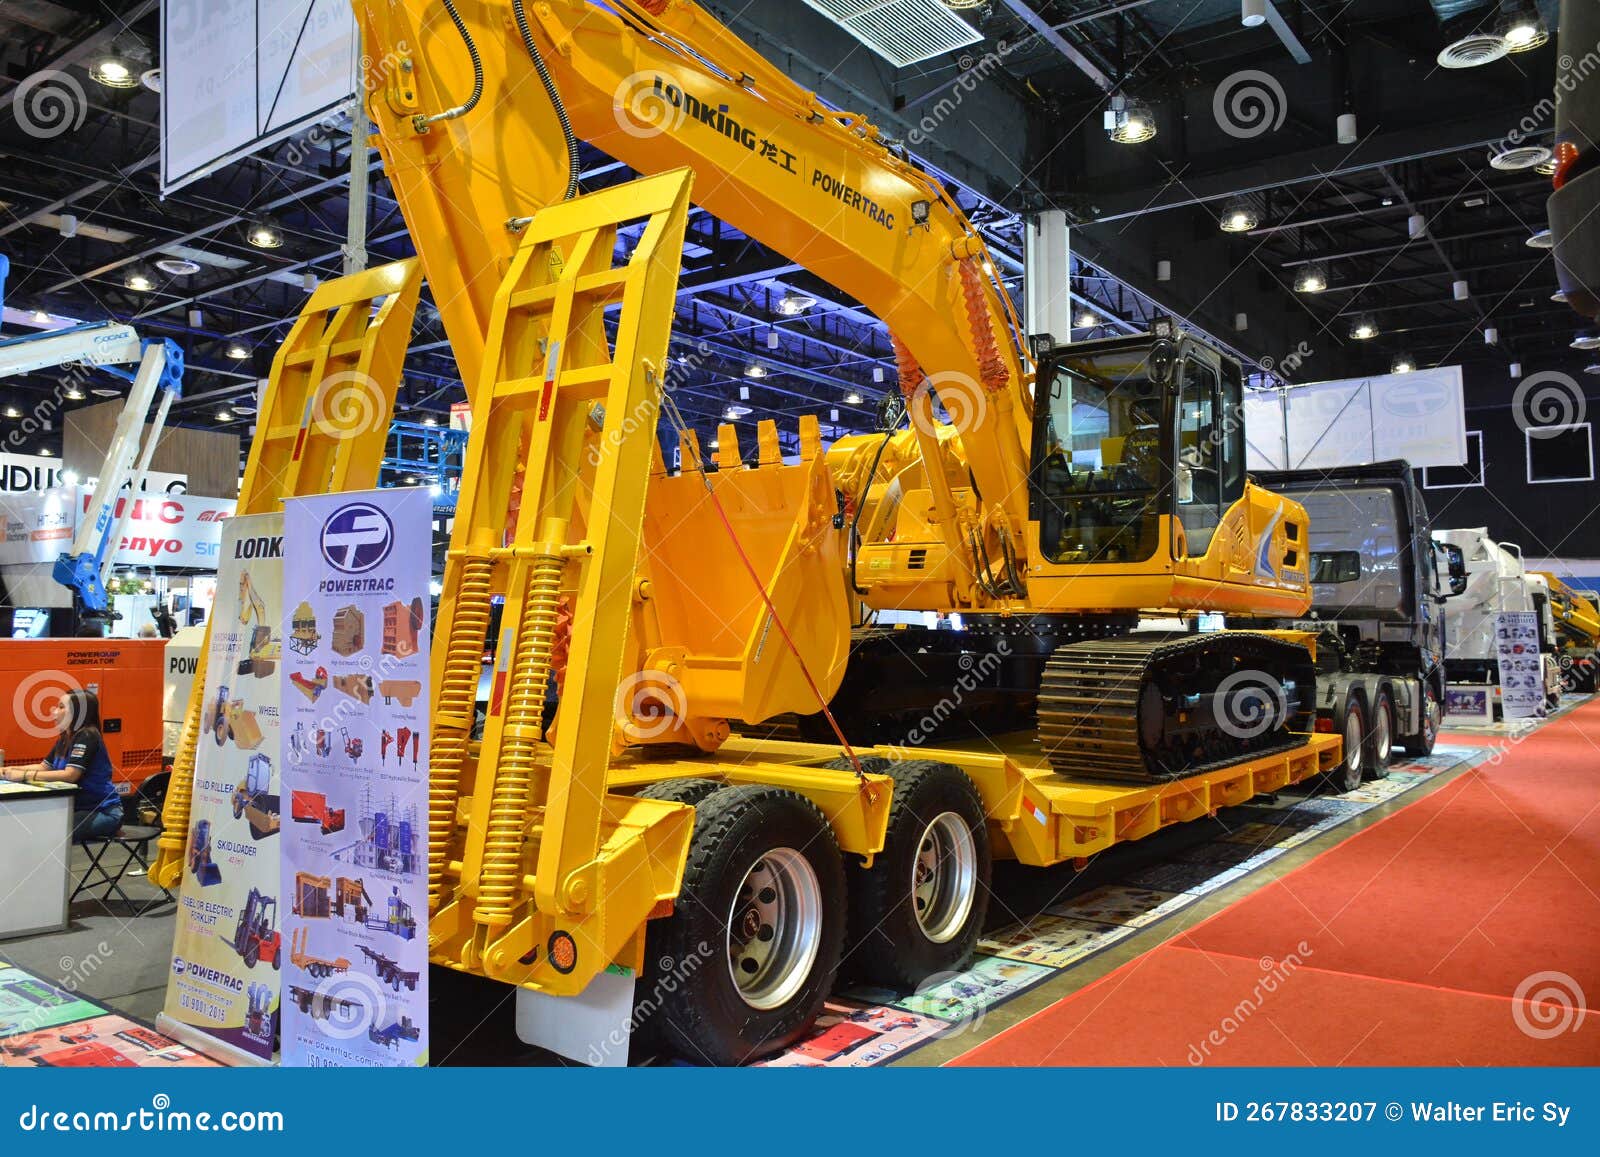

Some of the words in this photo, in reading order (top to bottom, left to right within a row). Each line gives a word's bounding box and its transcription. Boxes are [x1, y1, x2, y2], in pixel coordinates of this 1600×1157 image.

[812, 168, 894, 230] POWERTRAC
[107, 535, 183, 557] enyo
[235, 537, 284, 559] LONK
[319, 578, 394, 593] POWERTRAC
[258, 704, 279, 717] WHEEL
[217, 840, 232, 852] SKID
[233, 842, 257, 857] LOADER
[205, 903, 233, 918] ELECTRIC
[186, 962, 243, 991] POWERTRAC
[191, 998, 225, 1022] 9001:2015
